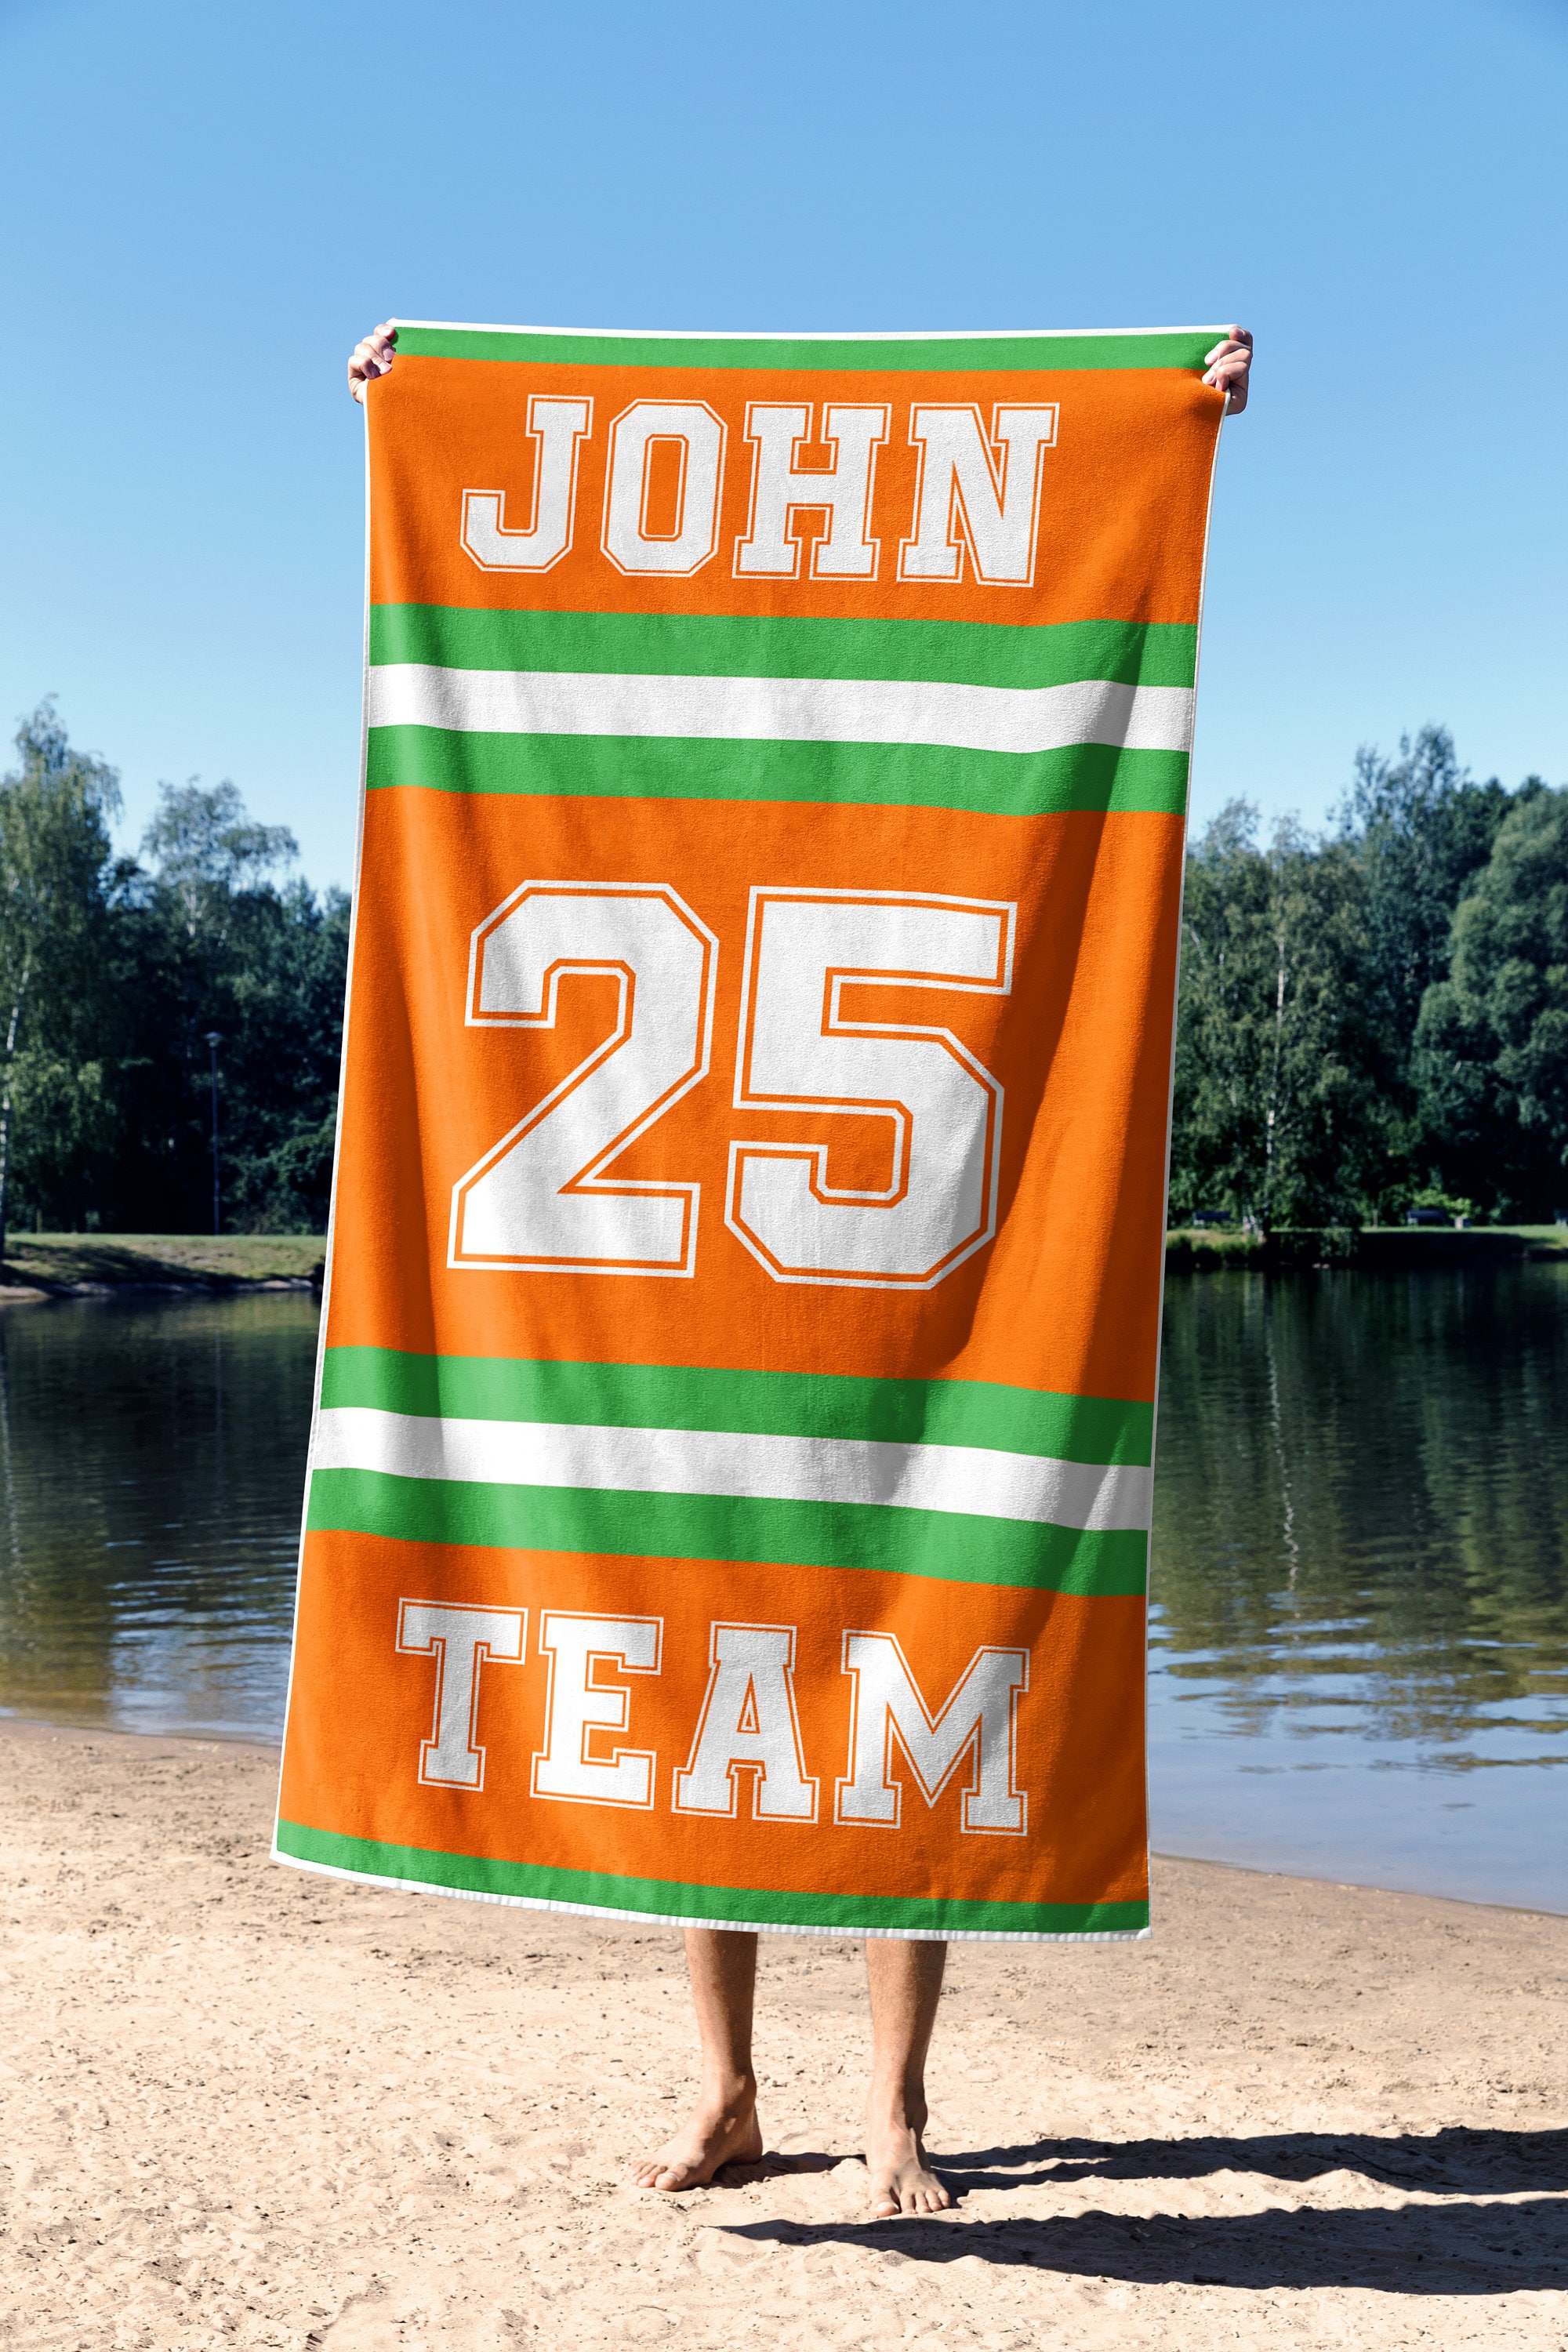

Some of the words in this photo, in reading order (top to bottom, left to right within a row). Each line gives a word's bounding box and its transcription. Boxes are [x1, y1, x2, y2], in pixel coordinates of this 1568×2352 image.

[460, 394, 1059, 587] JOHN
[447, 880, 1018, 1290] 25
[395, 1598, 1031, 1836] TEAM
